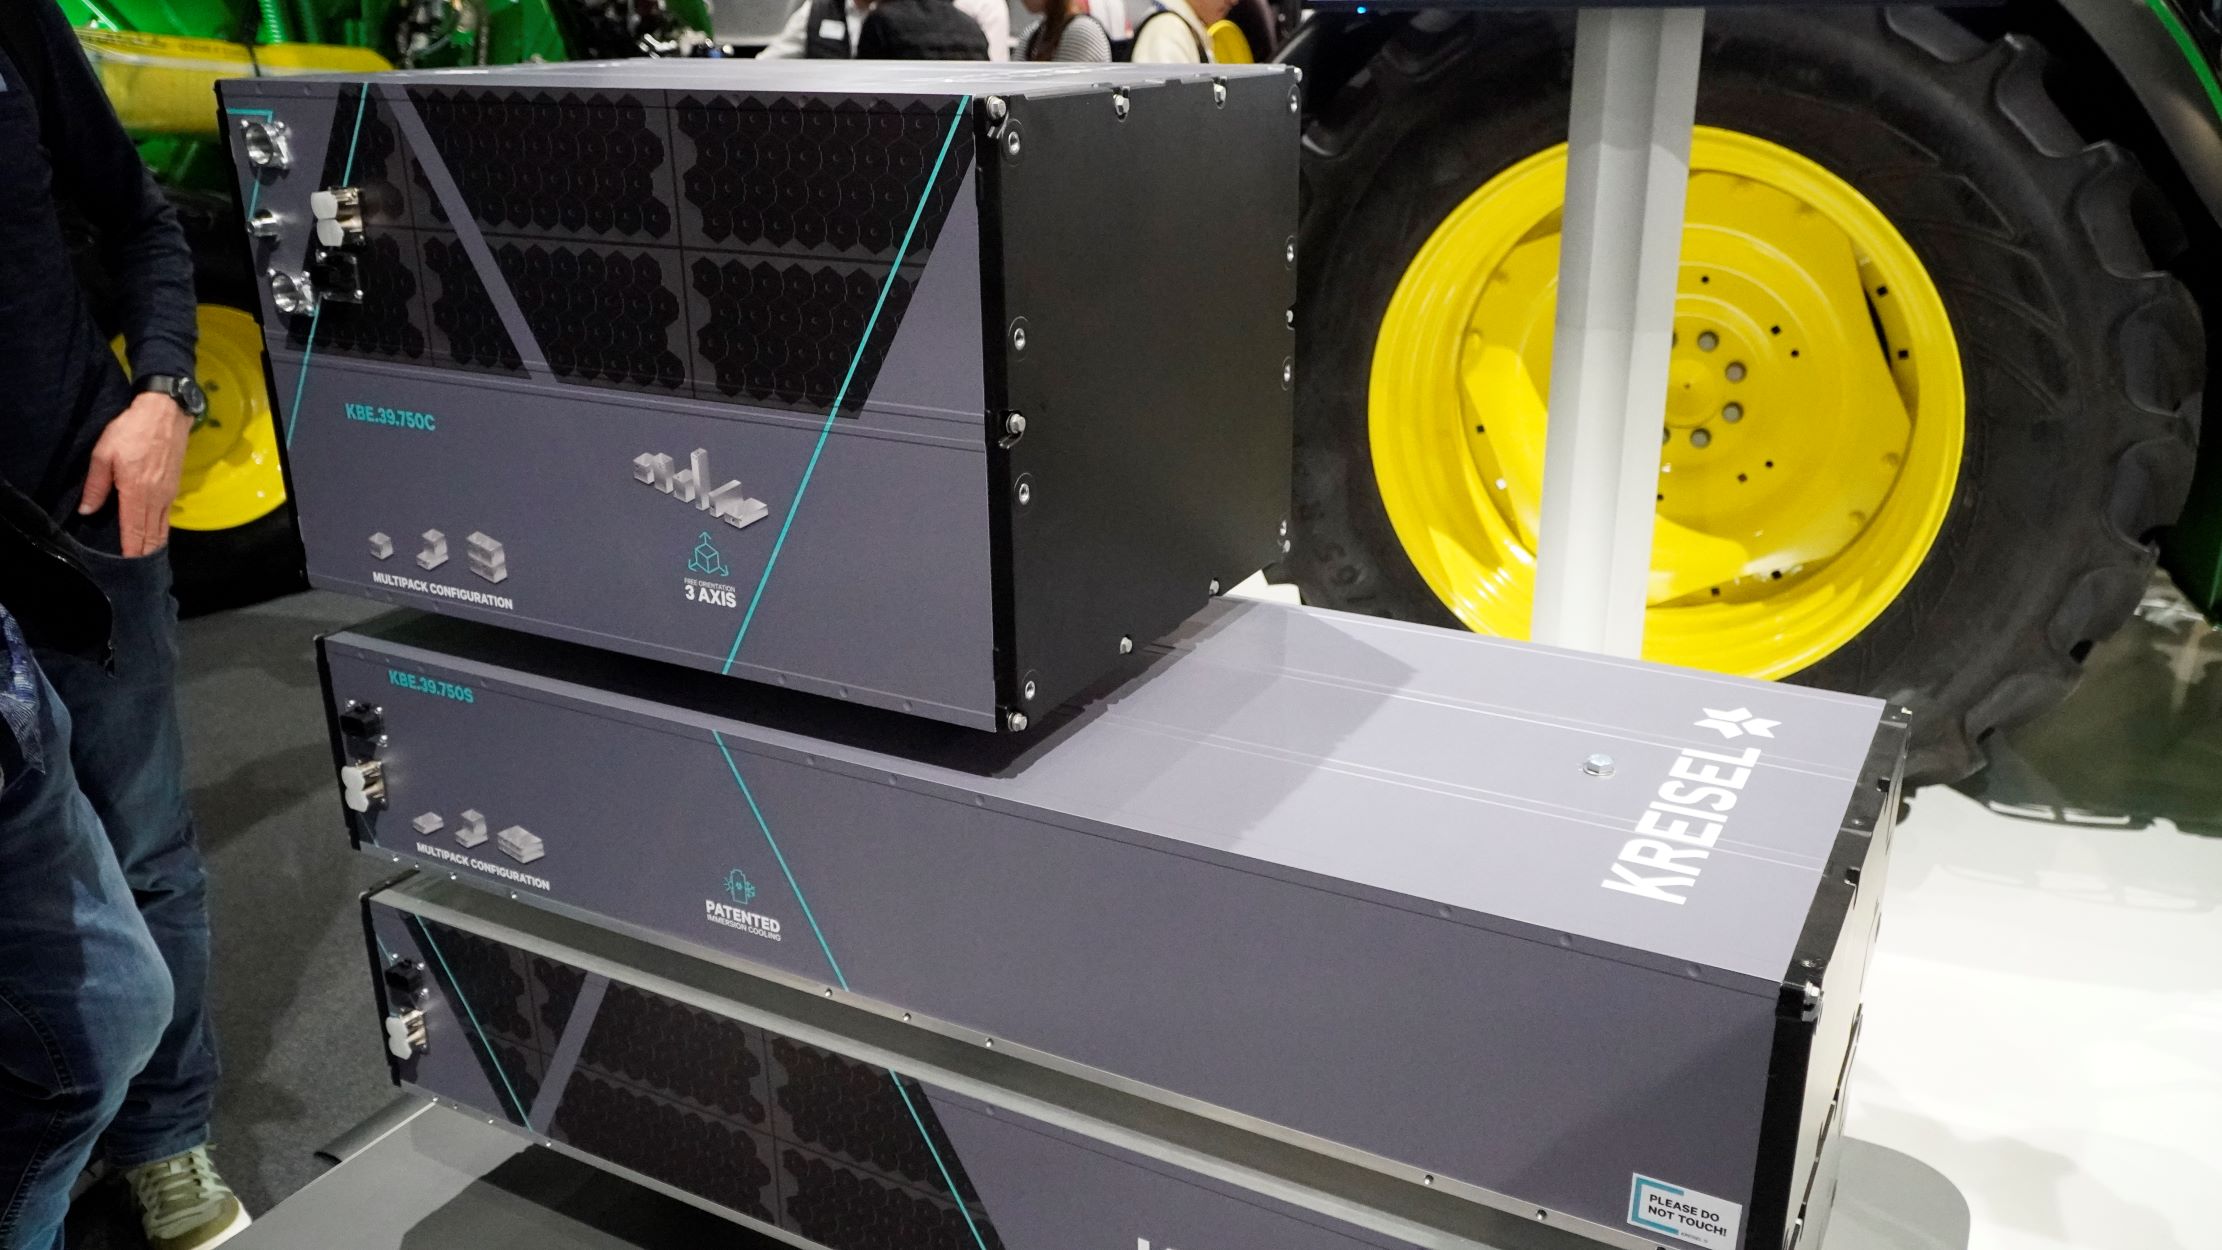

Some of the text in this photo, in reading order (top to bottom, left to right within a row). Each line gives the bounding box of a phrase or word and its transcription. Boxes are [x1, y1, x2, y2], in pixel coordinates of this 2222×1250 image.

[345, 403, 436, 431] KBE.39.750C
[372, 571, 514, 610] MULTIPACK CONFIGURATION
[685, 584, 737, 608] 3 AXIS
[388, 669, 474, 703] KBE.39.750S
[1601, 748, 1762, 905] KREISEL
[416, 842, 551, 891] MULTIPACK CONFIGURATION
[705, 899, 781, 933] PATENTED
[706, 914, 782, 942] IMMERSION COOLING
[1648, 1205, 1675, 1220] NOT
[1678, 1214, 1728, 1237] TOUCH!
[1650, 1194, 1720, 1222] PLEASE DO
